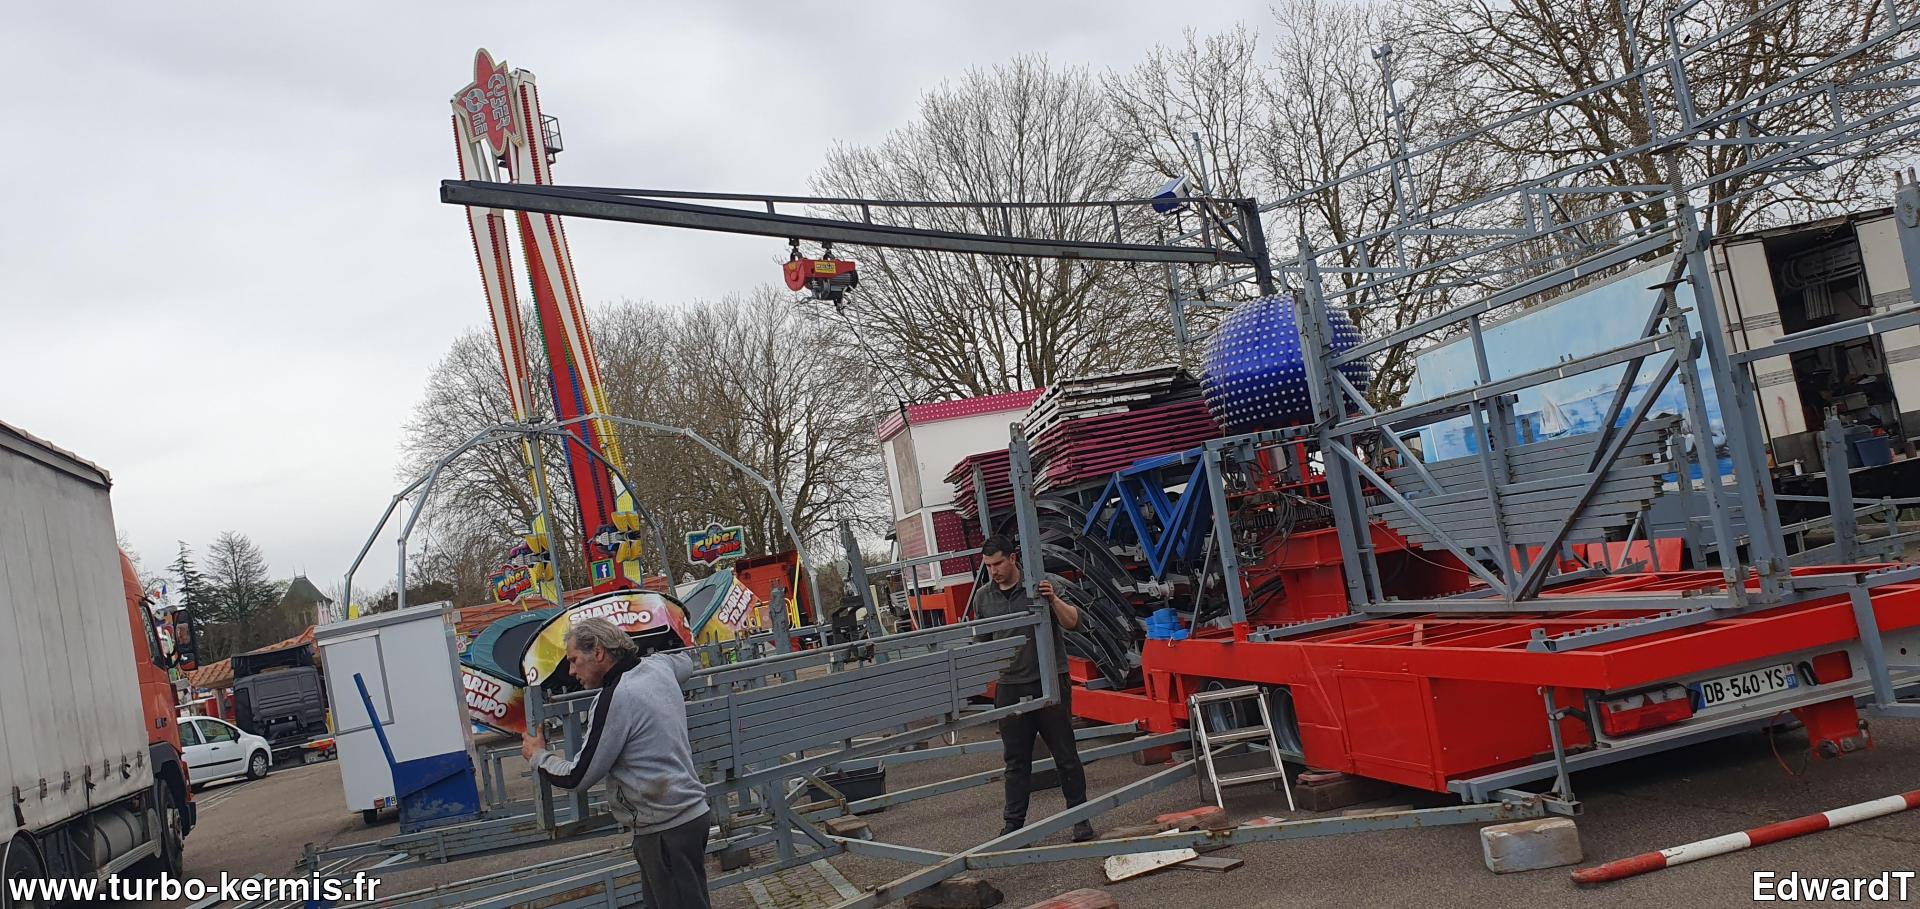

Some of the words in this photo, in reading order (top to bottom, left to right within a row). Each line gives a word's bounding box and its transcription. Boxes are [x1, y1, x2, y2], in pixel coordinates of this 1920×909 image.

[568, 600, 630, 626] SHARLY
[607, 610, 652, 627] AMPO
[462, 672, 501, 697] ARLY
[465, 690, 507, 718] AMPO
